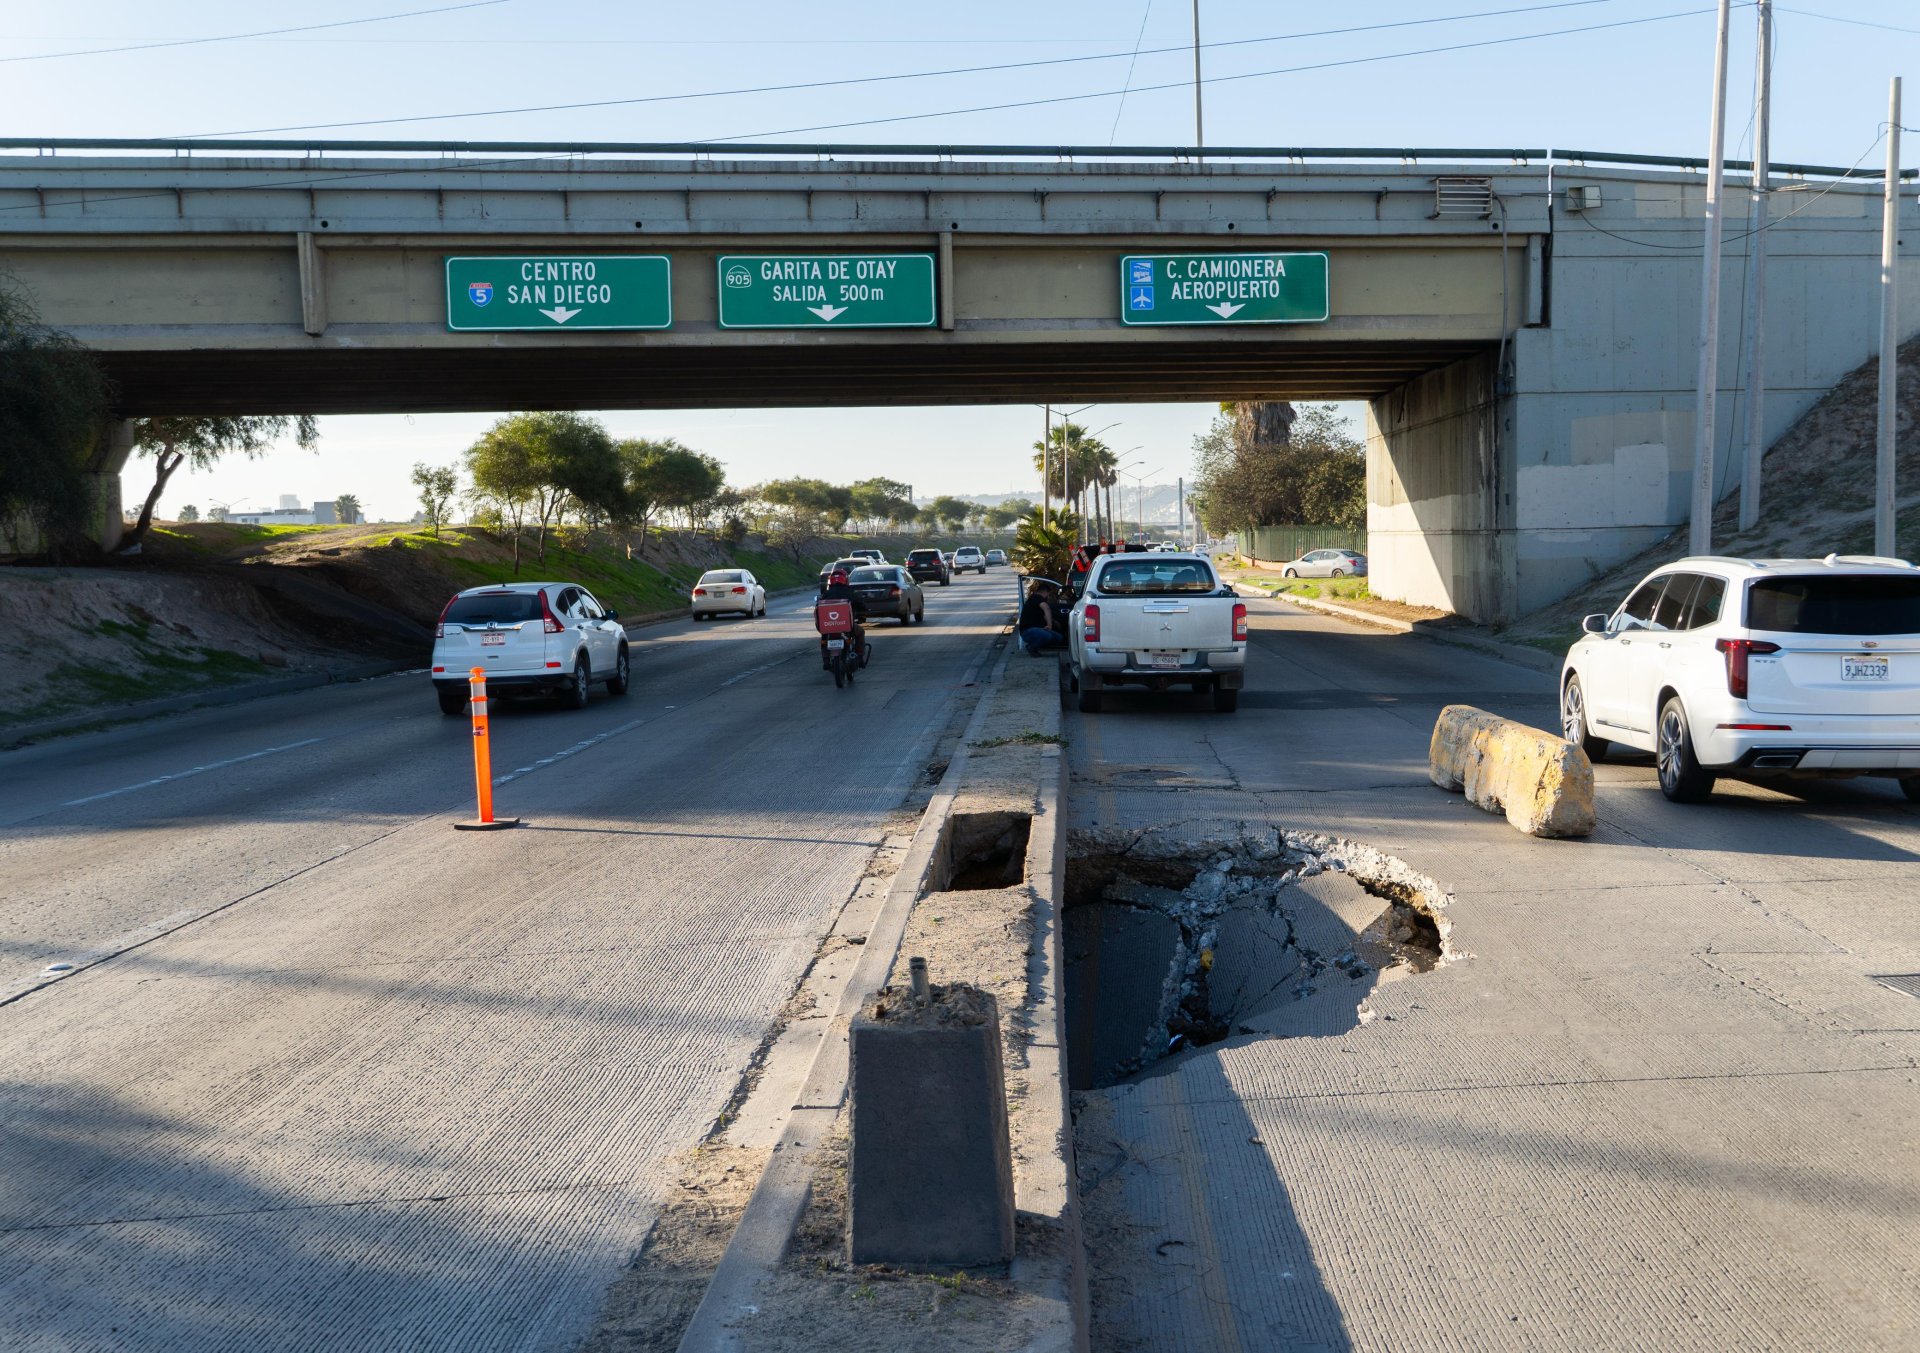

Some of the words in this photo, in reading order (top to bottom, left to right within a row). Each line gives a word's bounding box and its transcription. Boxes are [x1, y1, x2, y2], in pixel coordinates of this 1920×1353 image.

[521, 262, 596, 281] CENTRO
[761, 261, 822, 280] GARITA
[828, 261, 850, 280] DE
[856, 260, 897, 279] OTAY
[1166, 260, 1182, 279] C.
[1187, 259, 1286, 278] CAMIONERA
[728, 274, 750, 285] 905
[476, 289, 487, 303] 5
[508, 285, 546, 304] SAN
[554, 285, 611, 304] DIEGO
[773, 285, 827, 301] SALIDA
[1171, 280, 1280, 300] AEROPUERTO
[1845, 665, 1888, 677] 9JHZ339
